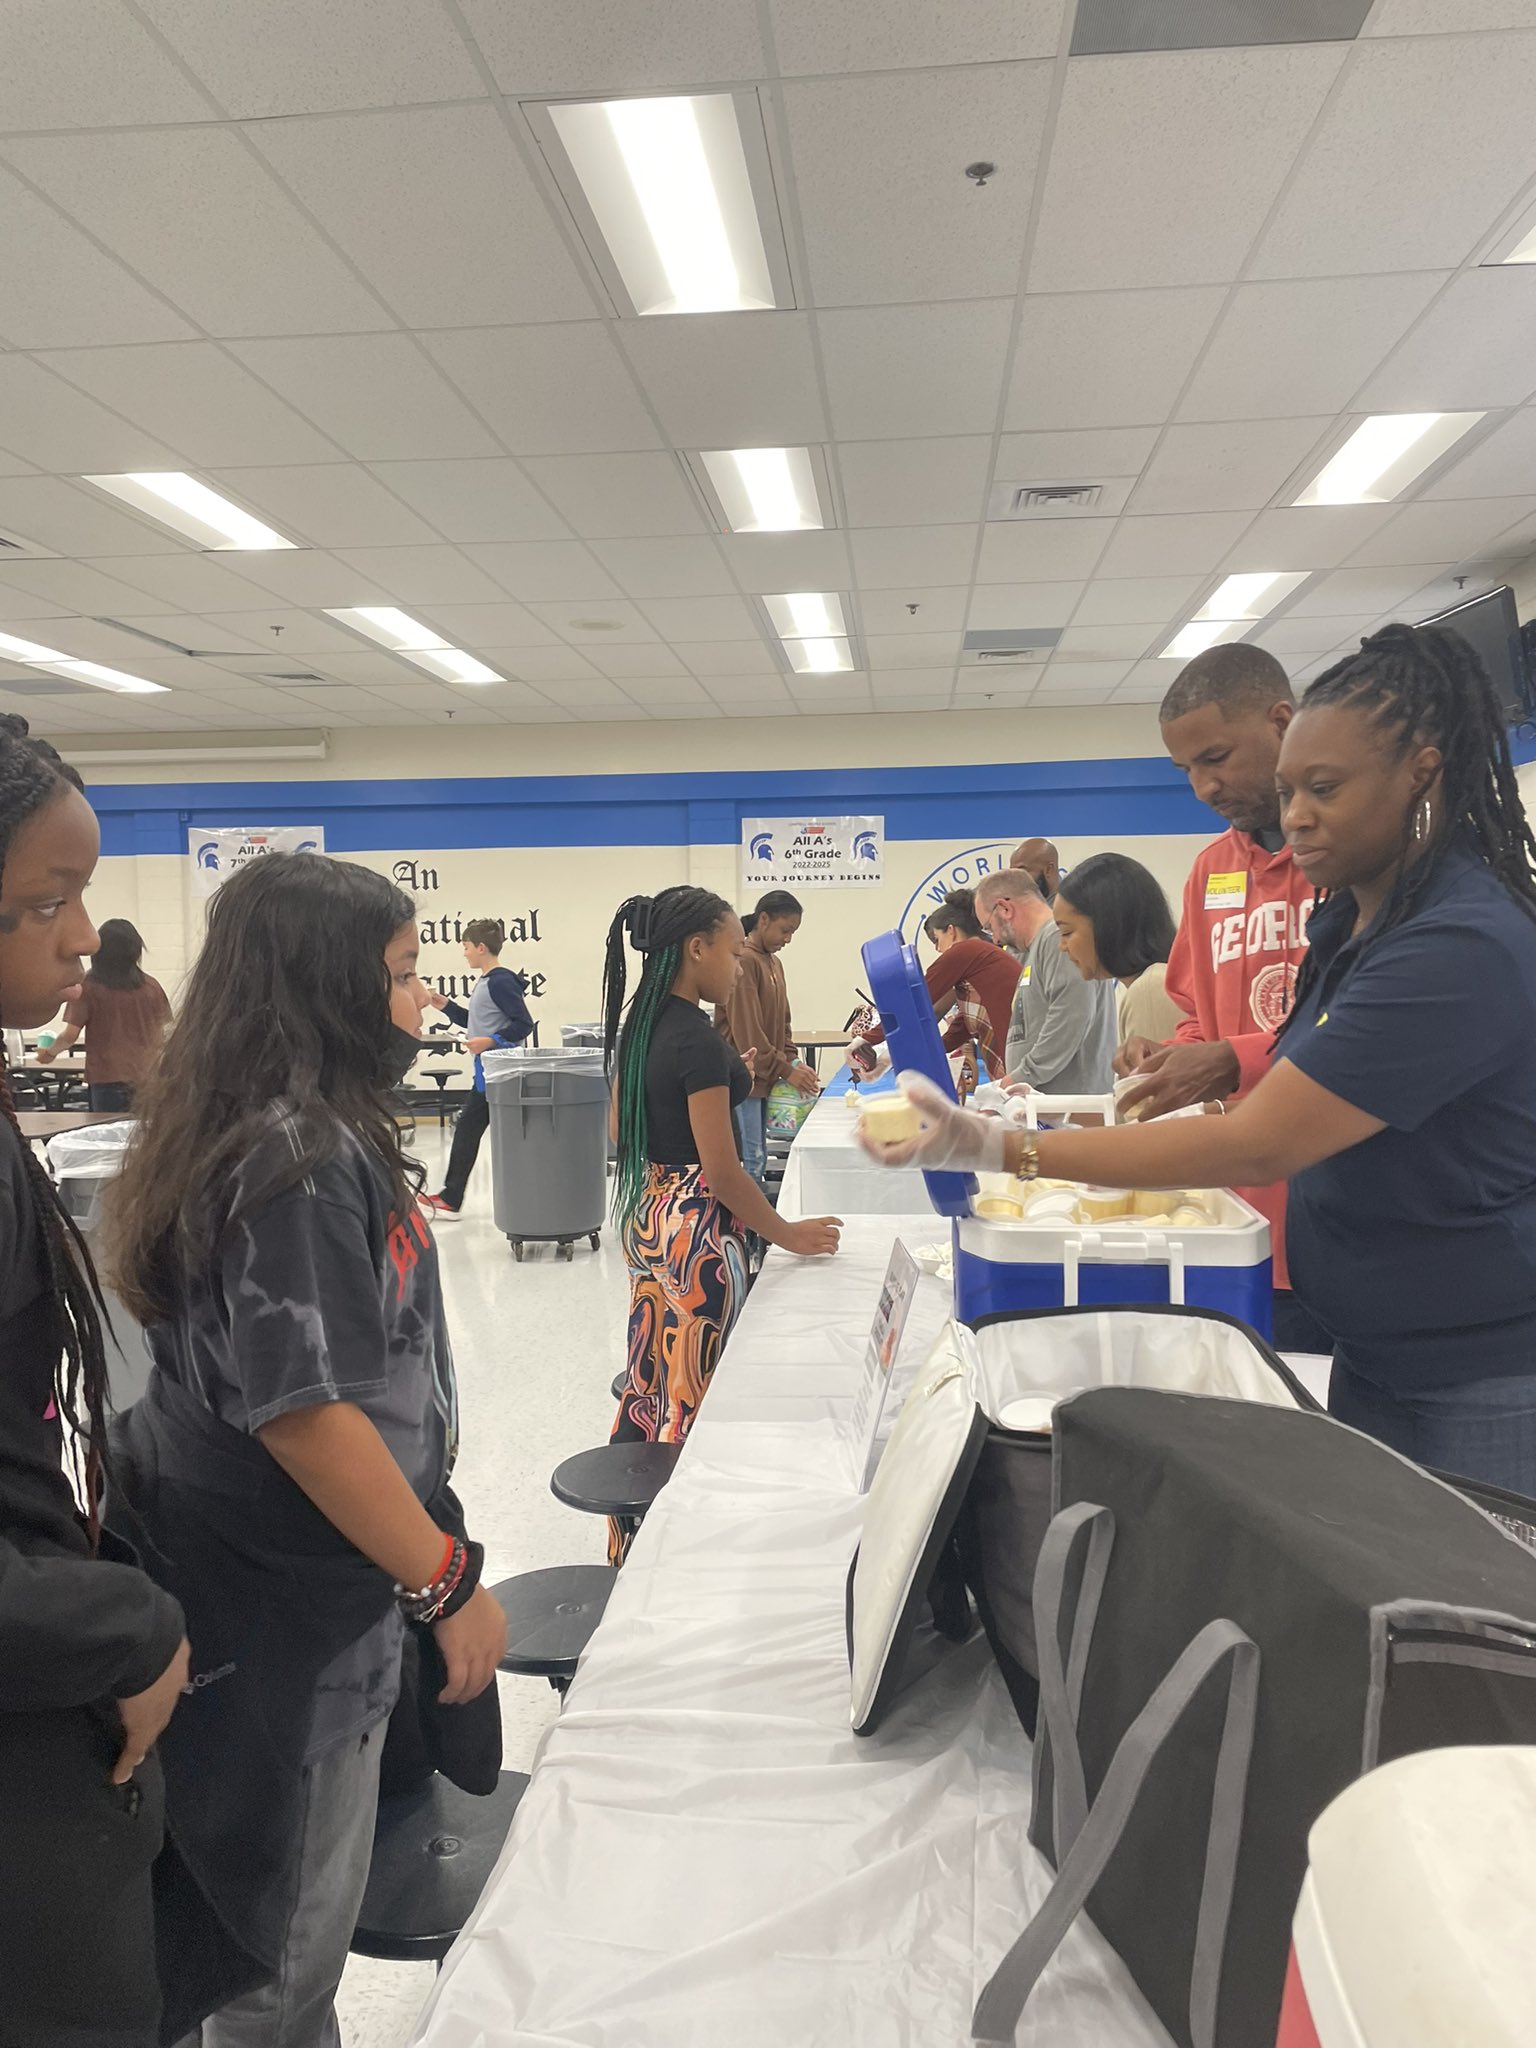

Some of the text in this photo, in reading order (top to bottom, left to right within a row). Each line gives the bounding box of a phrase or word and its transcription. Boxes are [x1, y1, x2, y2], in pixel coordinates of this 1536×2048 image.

[793, 835, 833, 846] All A's
[238, 846, 254, 855] All
[784, 849, 842, 860] 6th Grade
[392, 860, 440, 890] An
[782, 874, 834, 883] JOURNEY
[839, 874, 881, 882] BEGINS
